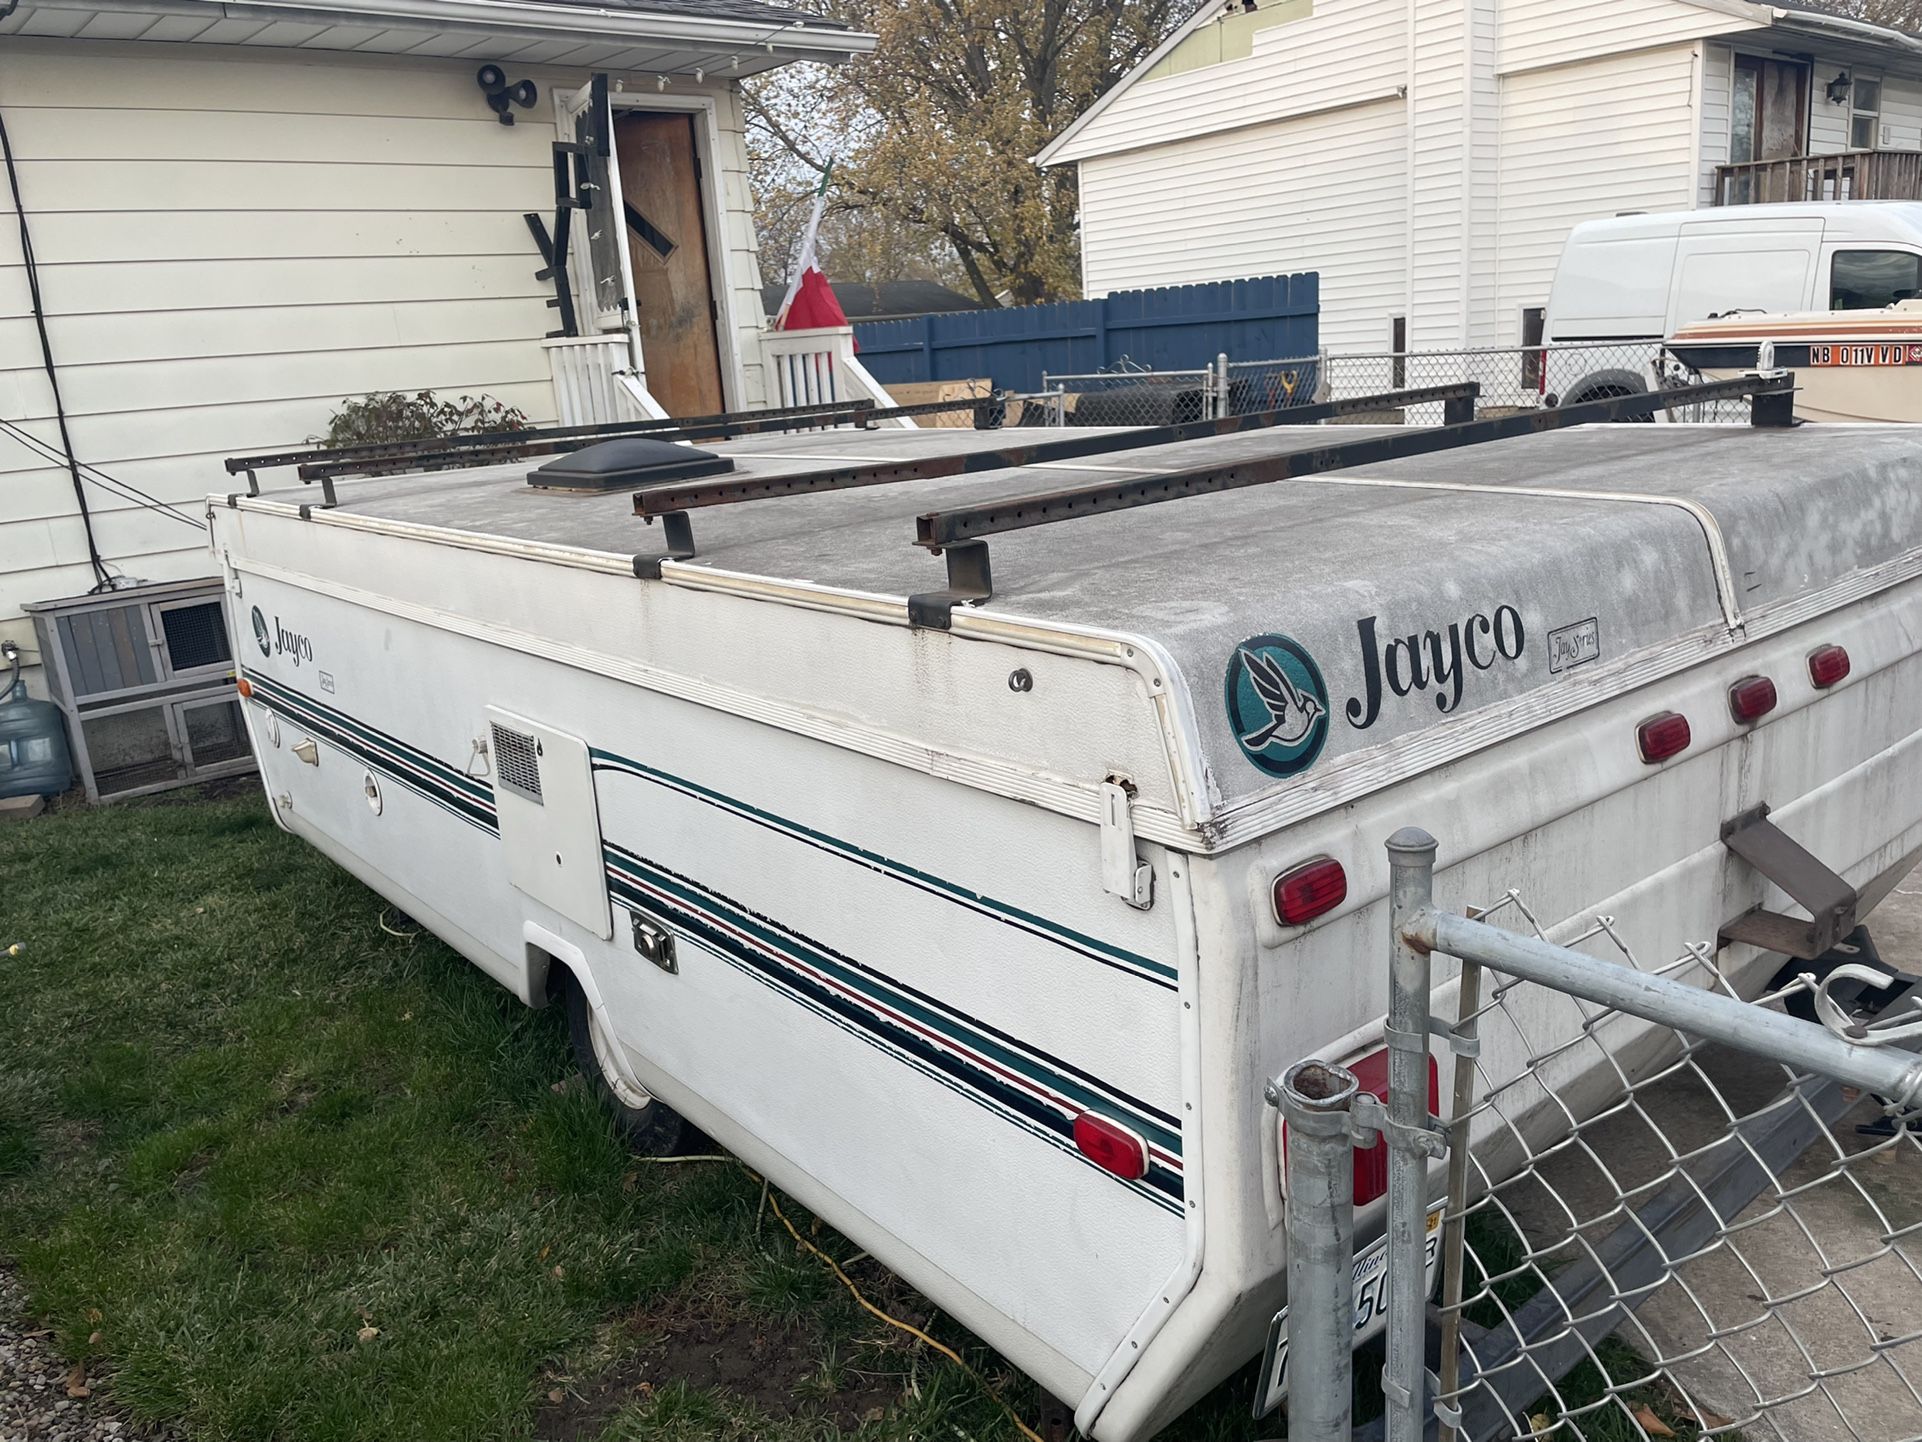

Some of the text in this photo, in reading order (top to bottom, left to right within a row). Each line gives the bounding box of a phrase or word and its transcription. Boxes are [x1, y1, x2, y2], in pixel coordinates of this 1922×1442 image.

[1811, 346, 1830, 364] NB
[1880, 346, 1902, 363] VD
[274, 616, 313, 667] Jayco
[1553, 636, 1571, 665] Jay
[1346, 604, 1525, 730] Jayco
